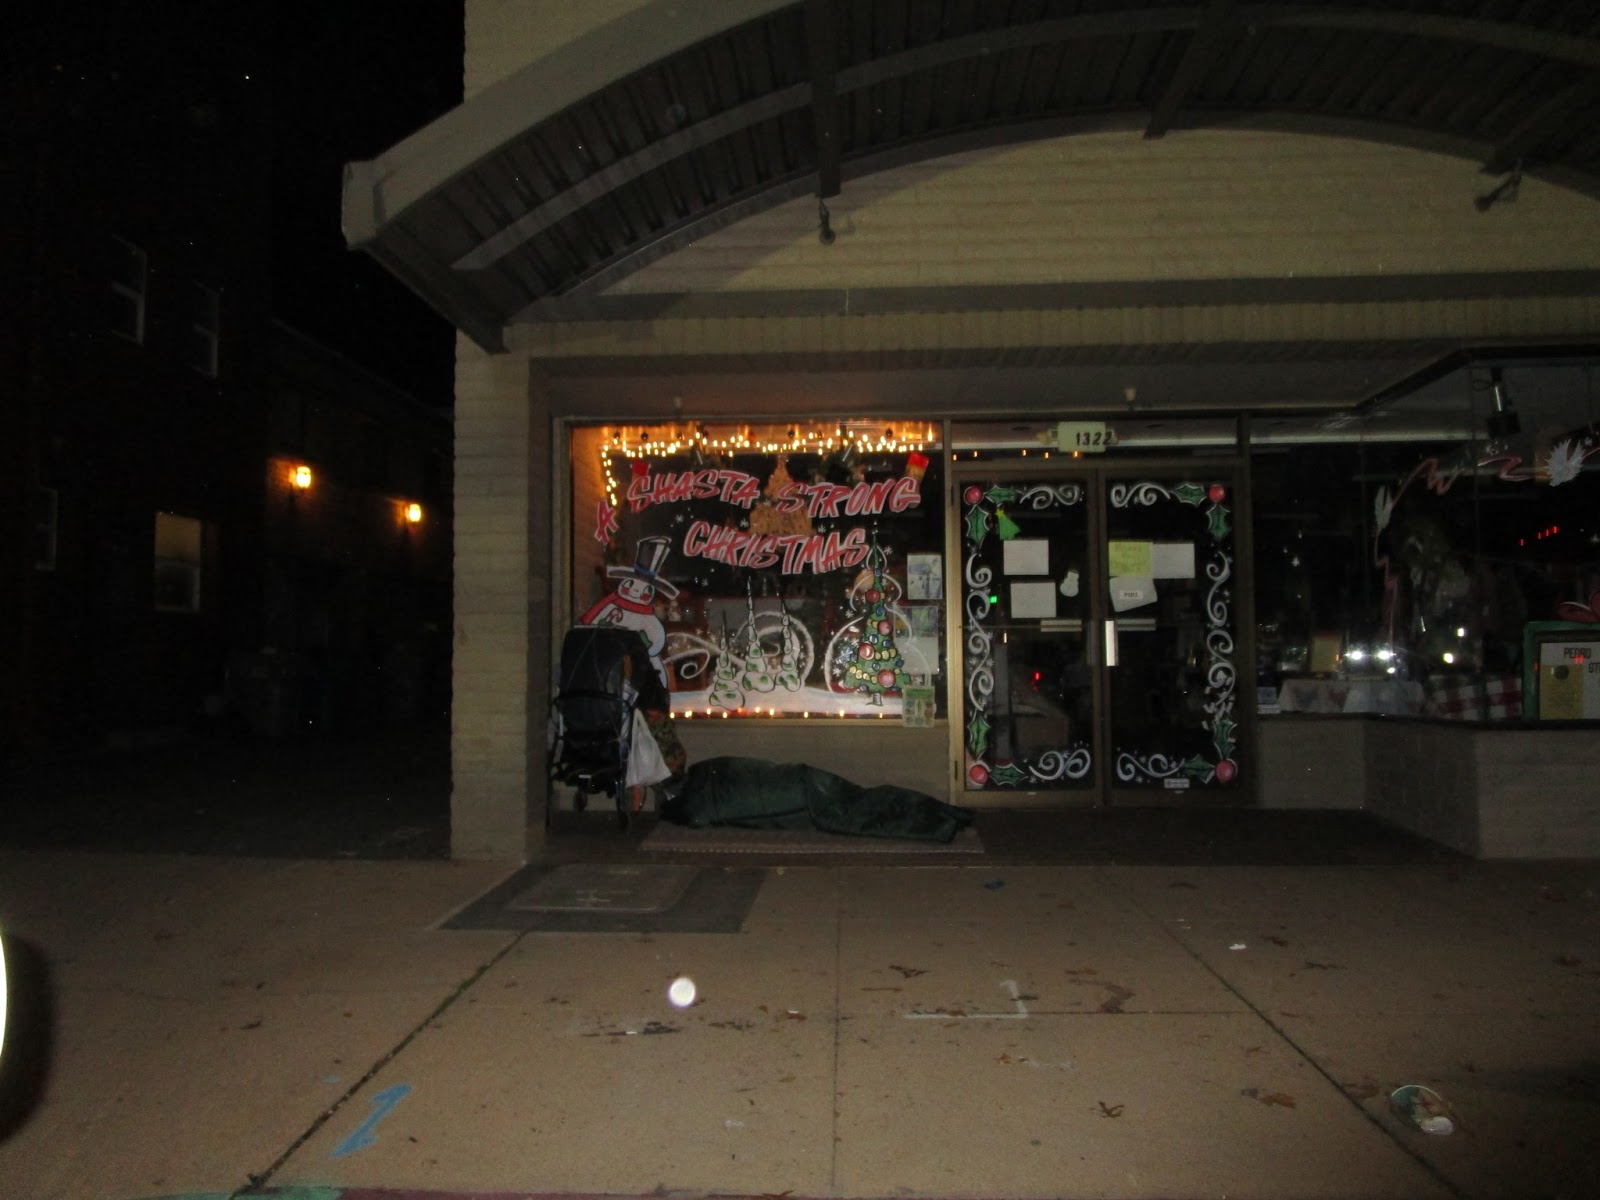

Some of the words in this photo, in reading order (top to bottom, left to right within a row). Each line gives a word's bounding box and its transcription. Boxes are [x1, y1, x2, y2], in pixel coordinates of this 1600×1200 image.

[1076, 432, 1112, 446] 1322
[627, 469, 760, 512] SHASTA
[776, 477, 921, 518] STRONG
[684, 521, 870, 575] CHRISTMAS
